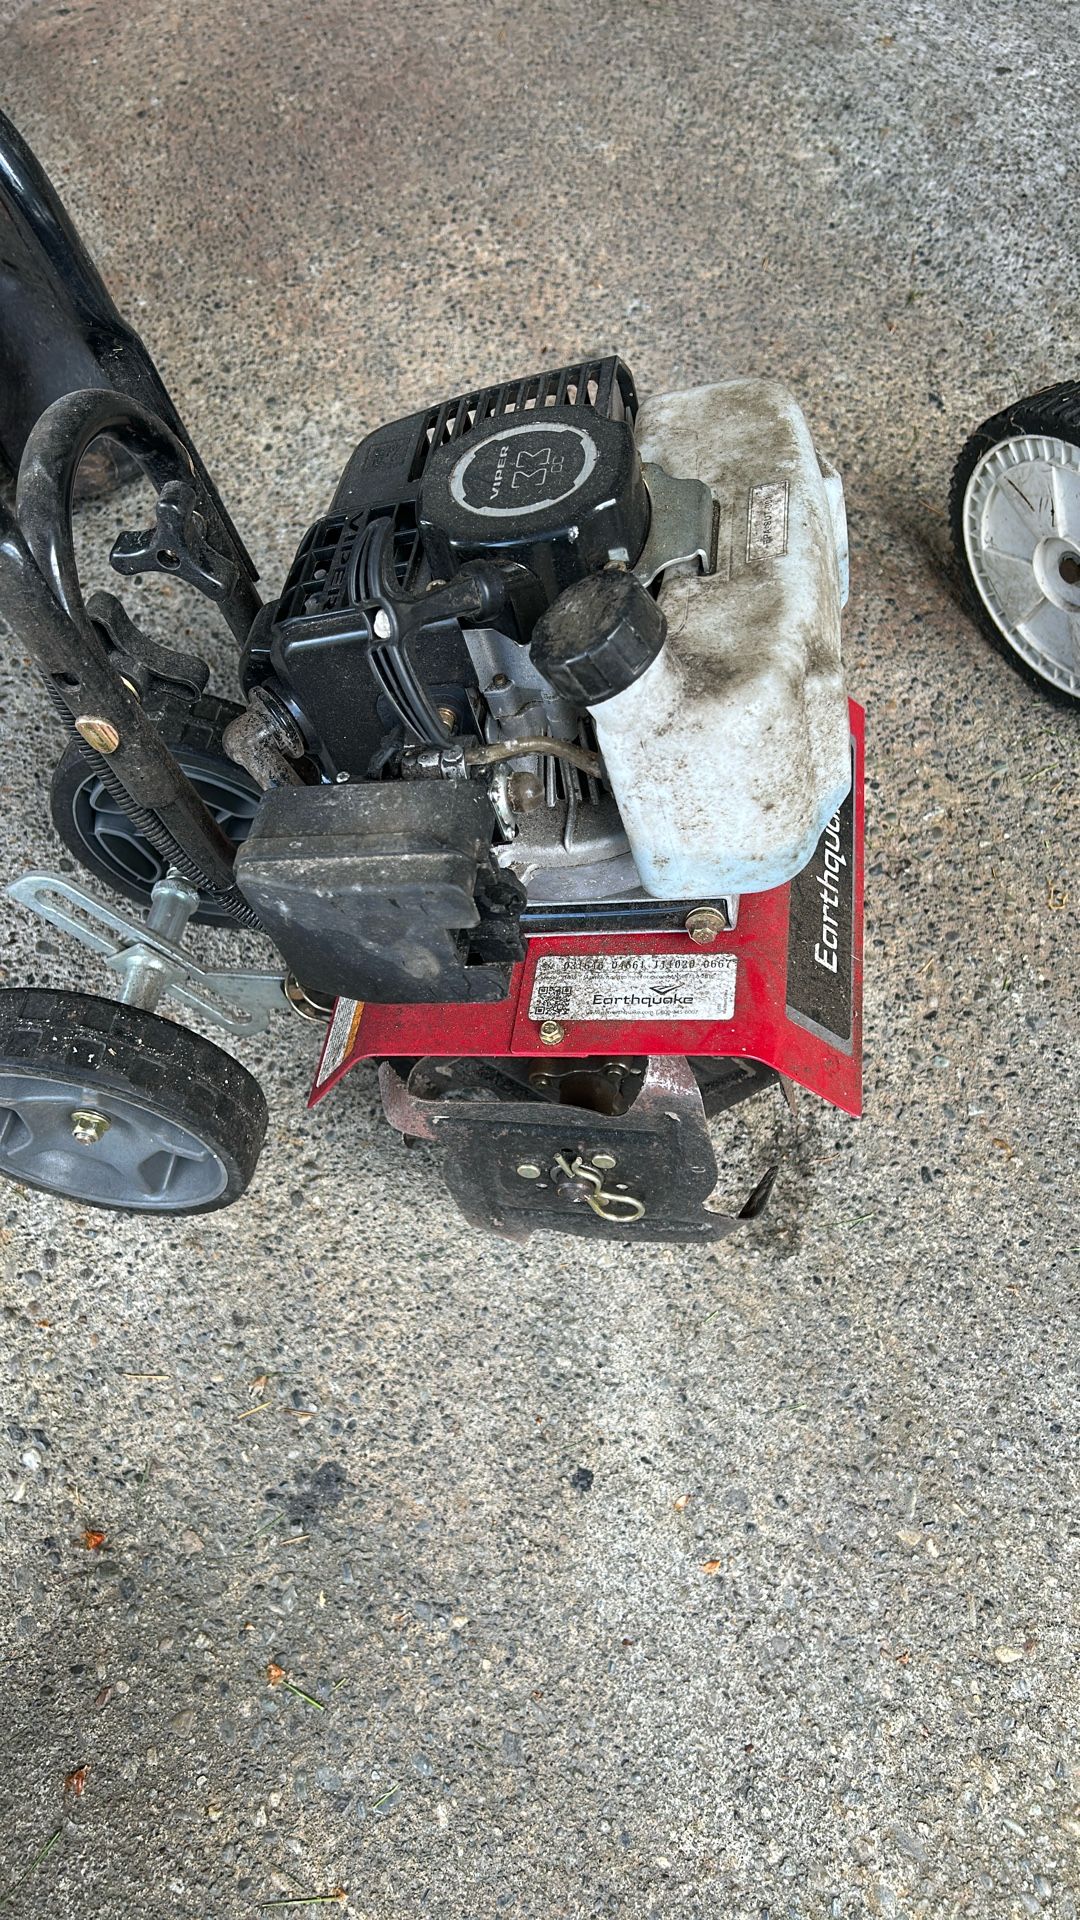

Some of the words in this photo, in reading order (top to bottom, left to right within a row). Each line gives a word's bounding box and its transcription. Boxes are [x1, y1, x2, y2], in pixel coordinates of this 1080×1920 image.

[490, 445, 510, 500] VIPER
[814, 809, 847, 974] Earthqua
[592, 994, 694, 1007] Earthquake
